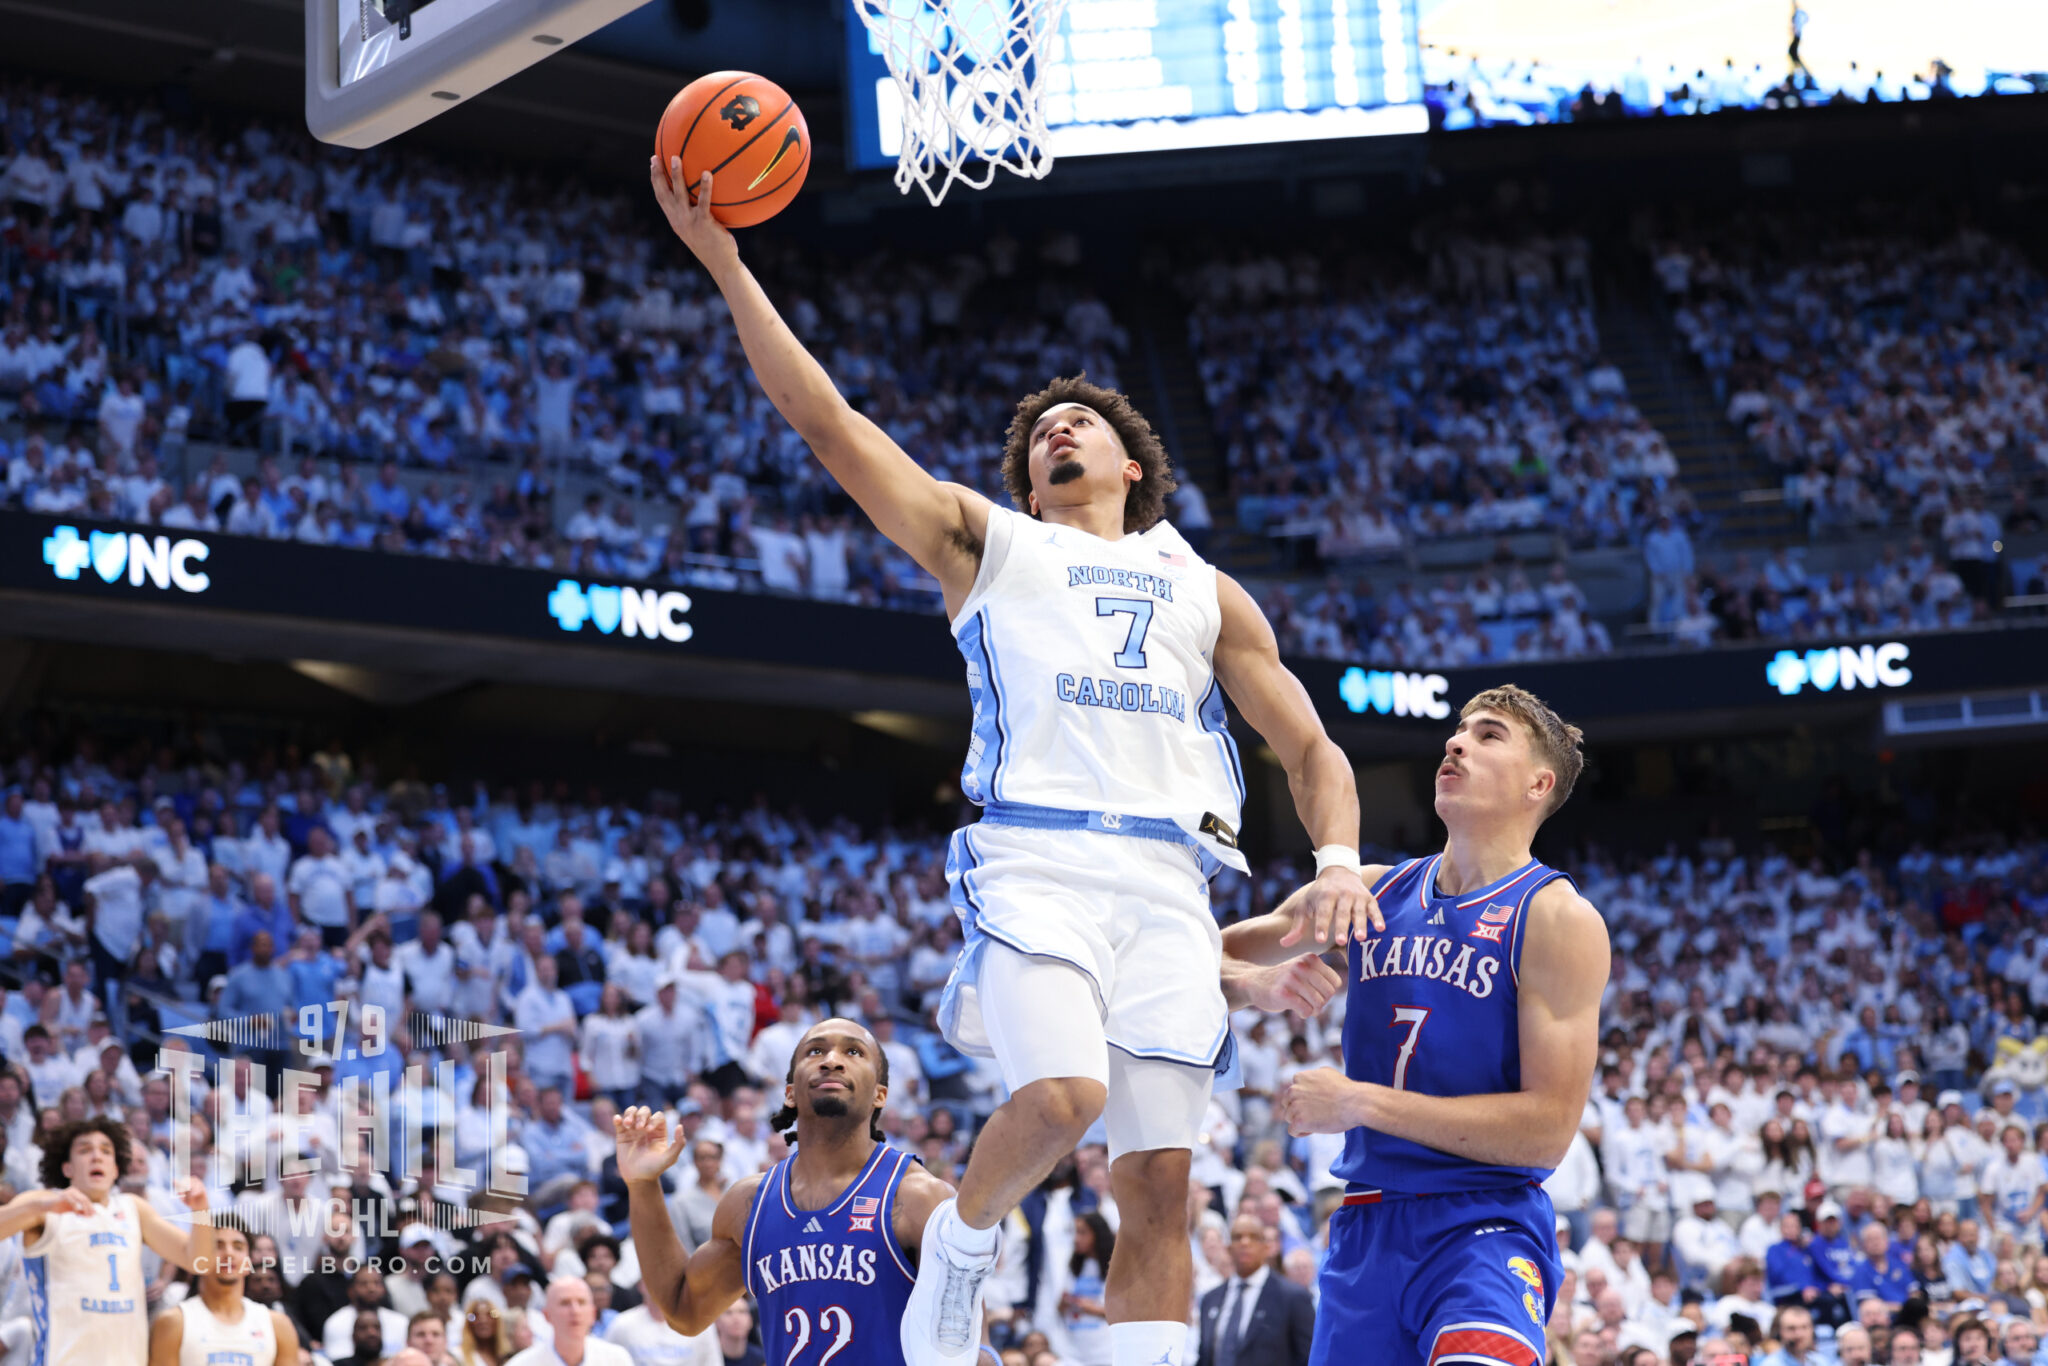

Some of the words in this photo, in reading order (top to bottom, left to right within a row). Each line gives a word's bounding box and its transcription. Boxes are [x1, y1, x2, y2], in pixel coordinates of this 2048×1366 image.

[1067, 566, 1173, 603] NORTH
[1095, 597, 1154, 669] 7
[1360, 936, 1500, 998] KANSAS
[1389, 1004, 1432, 1091] 7
[107, 1254, 120, 1292] 1
[756, 1243, 877, 1294] KANSAS
[784, 1304, 855, 1366] 22
